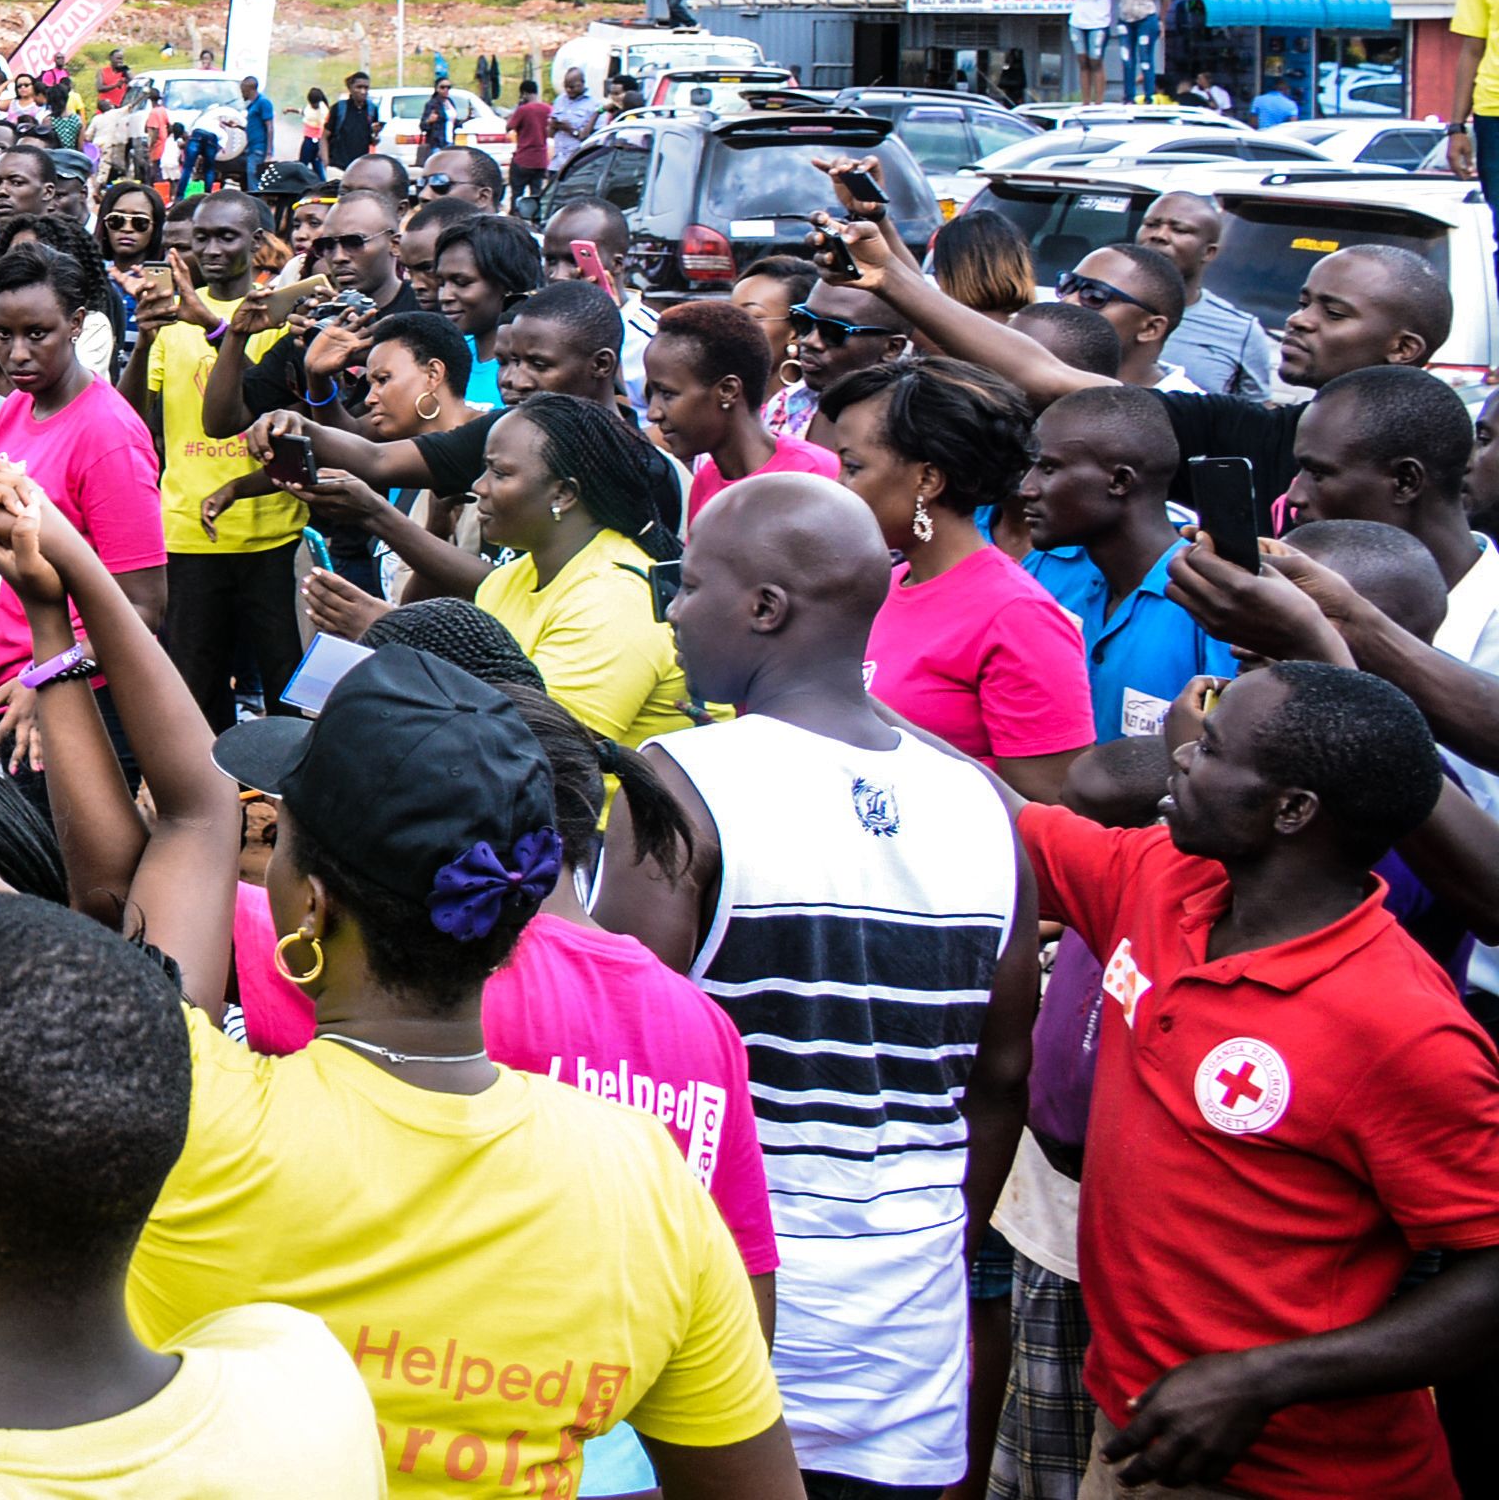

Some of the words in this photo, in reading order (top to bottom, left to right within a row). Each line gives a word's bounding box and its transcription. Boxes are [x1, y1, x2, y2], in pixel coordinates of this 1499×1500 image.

[184, 441, 249, 458] #ForCa
[1202, 1045, 1244, 1076] UGANDA
[1252, 1047, 1274, 1066] RED
[1265, 1069, 1281, 1113] CROSS
[1204, 1098, 1248, 1129] SOCIETY
[353, 1325, 573, 1407] Helped
